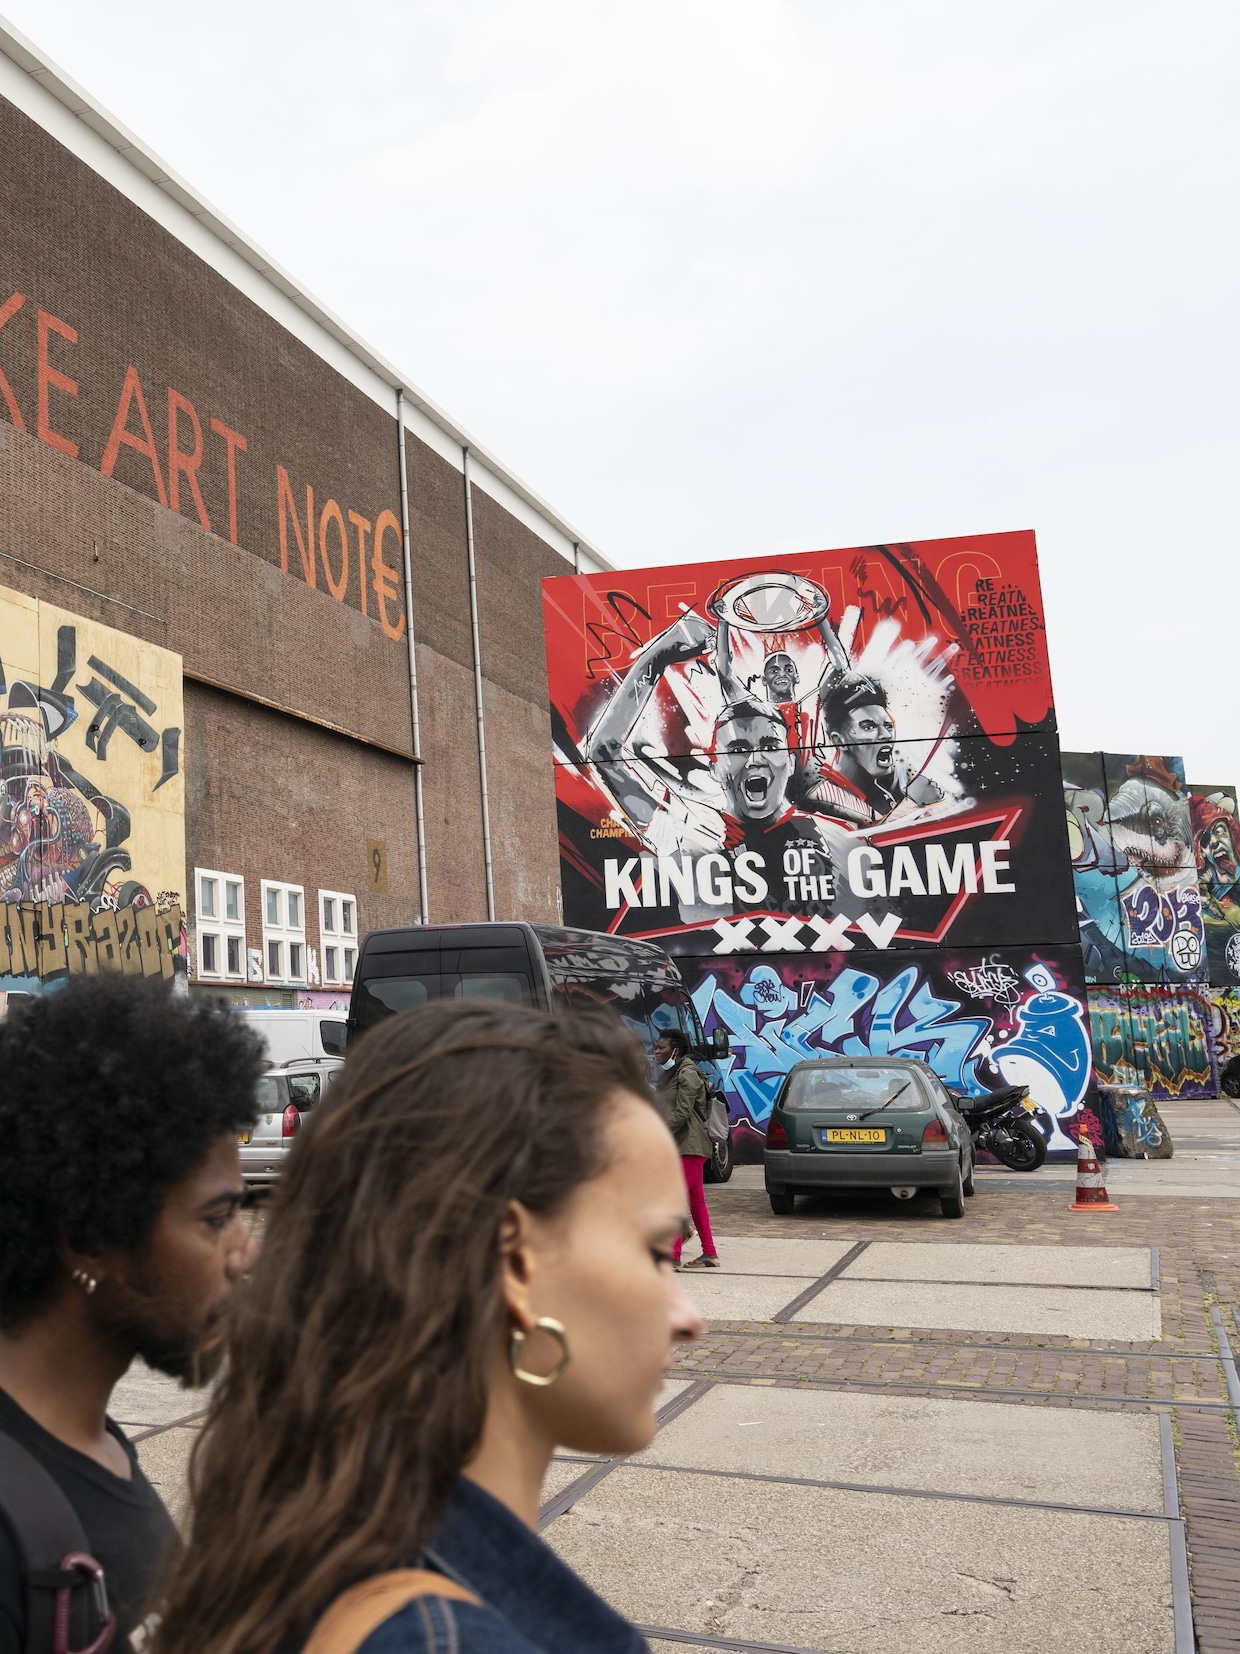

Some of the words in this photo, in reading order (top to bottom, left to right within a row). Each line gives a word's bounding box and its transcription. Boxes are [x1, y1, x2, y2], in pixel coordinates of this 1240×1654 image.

[100, 365, 247, 545] ART
[604, 852, 768, 909] KINGS
[783, 848, 816, 875] OF
[847, 840, 1016, 898] GAME
[783, 874, 835, 901] THE
[832, 1130, 880, 1140] PL-NL-10
